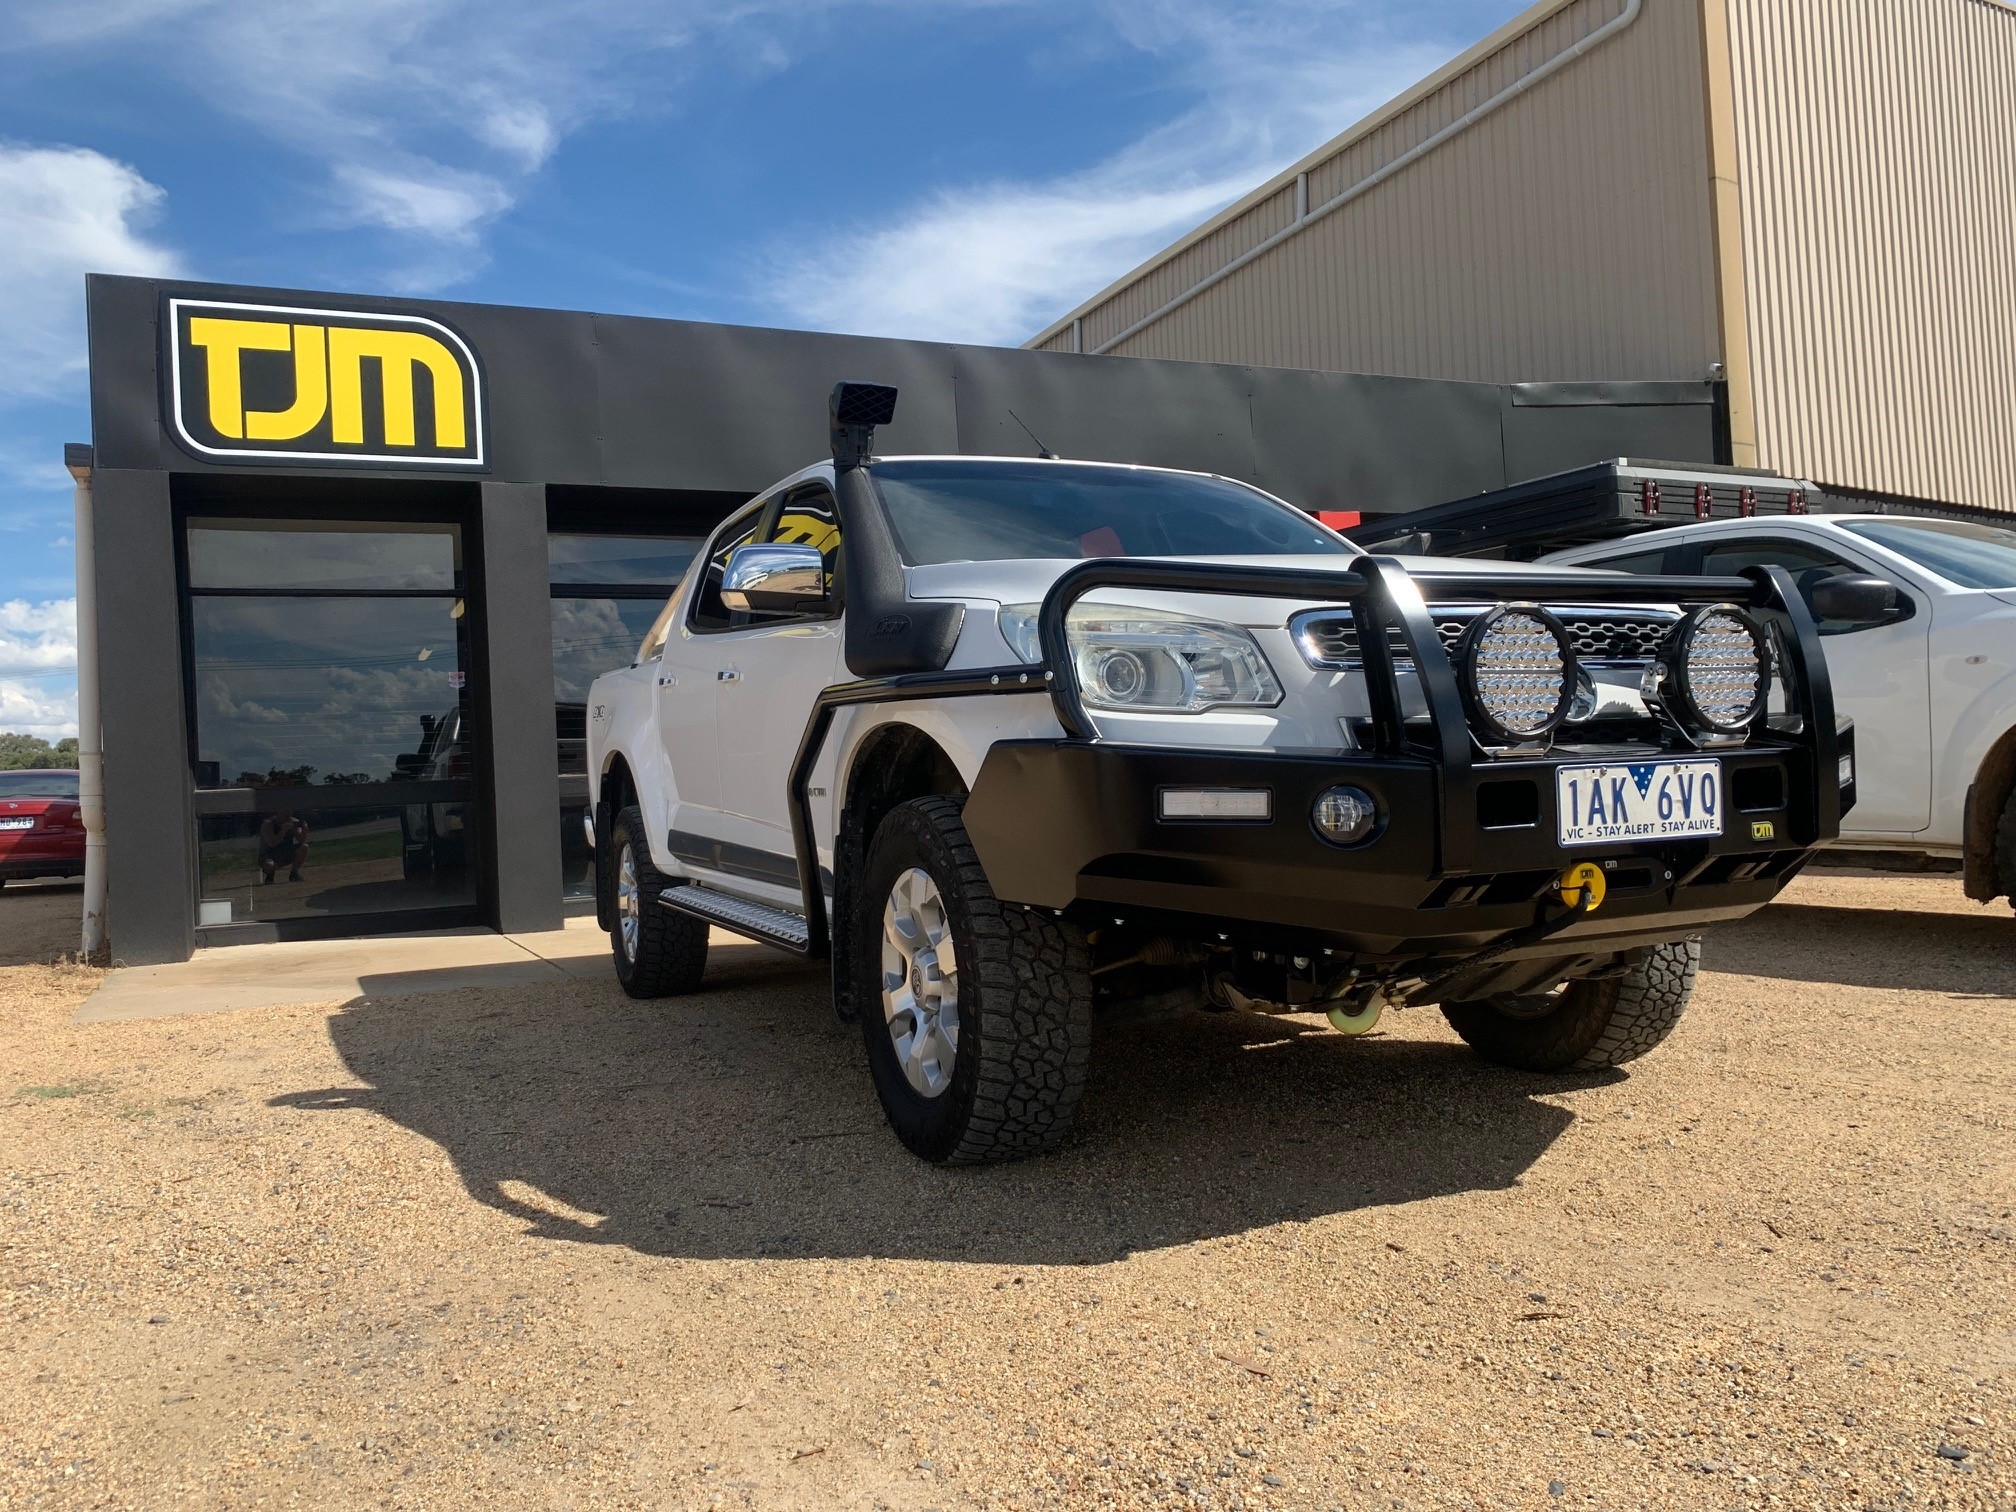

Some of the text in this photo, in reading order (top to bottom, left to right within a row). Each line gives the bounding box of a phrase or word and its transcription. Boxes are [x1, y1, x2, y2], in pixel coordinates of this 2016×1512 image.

[190, 317, 466, 448] TJM
[1569, 773, 1716, 827] 1AK 6VQ
[1567, 828, 1584, 839] VIC
[1596, 825, 1622, 838] STAY
[1624, 823, 1655, 835] ALERT
[1661, 821, 1685, 833] STAY
[1688, 819, 1715, 831] ALIVE
